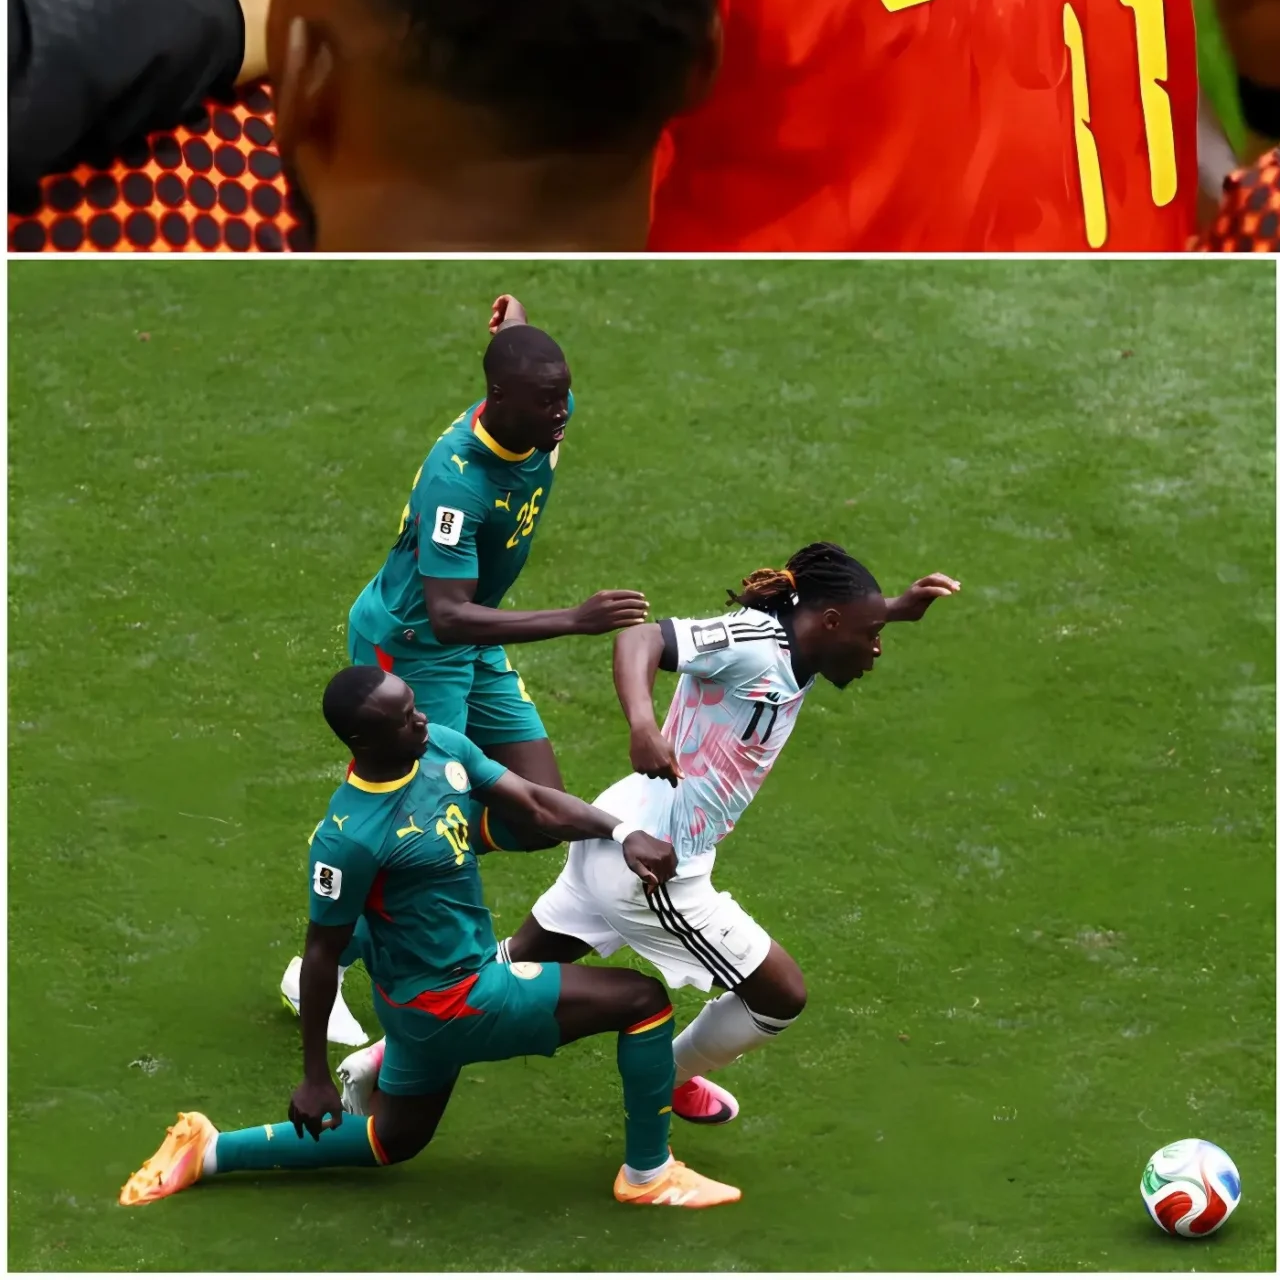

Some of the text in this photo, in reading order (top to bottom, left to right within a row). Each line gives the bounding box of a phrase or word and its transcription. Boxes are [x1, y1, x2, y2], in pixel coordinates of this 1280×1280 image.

[506, 487, 543, 549] 26
[741, 701, 779, 745] 11
[435, 803, 470, 866] 10
